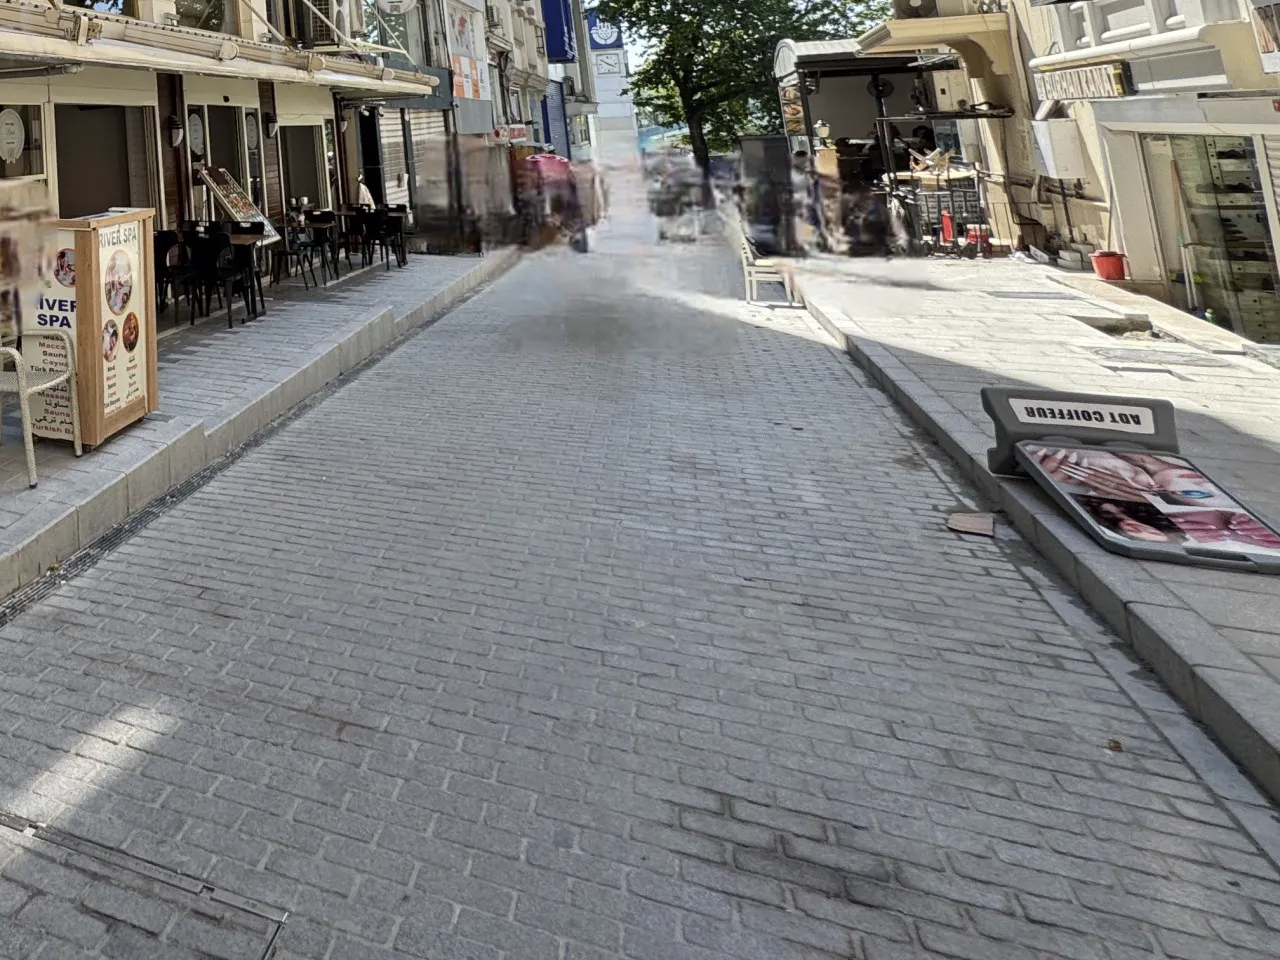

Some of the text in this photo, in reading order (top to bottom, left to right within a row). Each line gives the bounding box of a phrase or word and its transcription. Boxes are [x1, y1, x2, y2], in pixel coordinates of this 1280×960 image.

[99, 226, 137, 248] RIVER SPA
[37, 313, 72, 329] SPA
[37, 390, 71, 402] Massag
[1024, 406, 1104, 422] COIFFEUR
